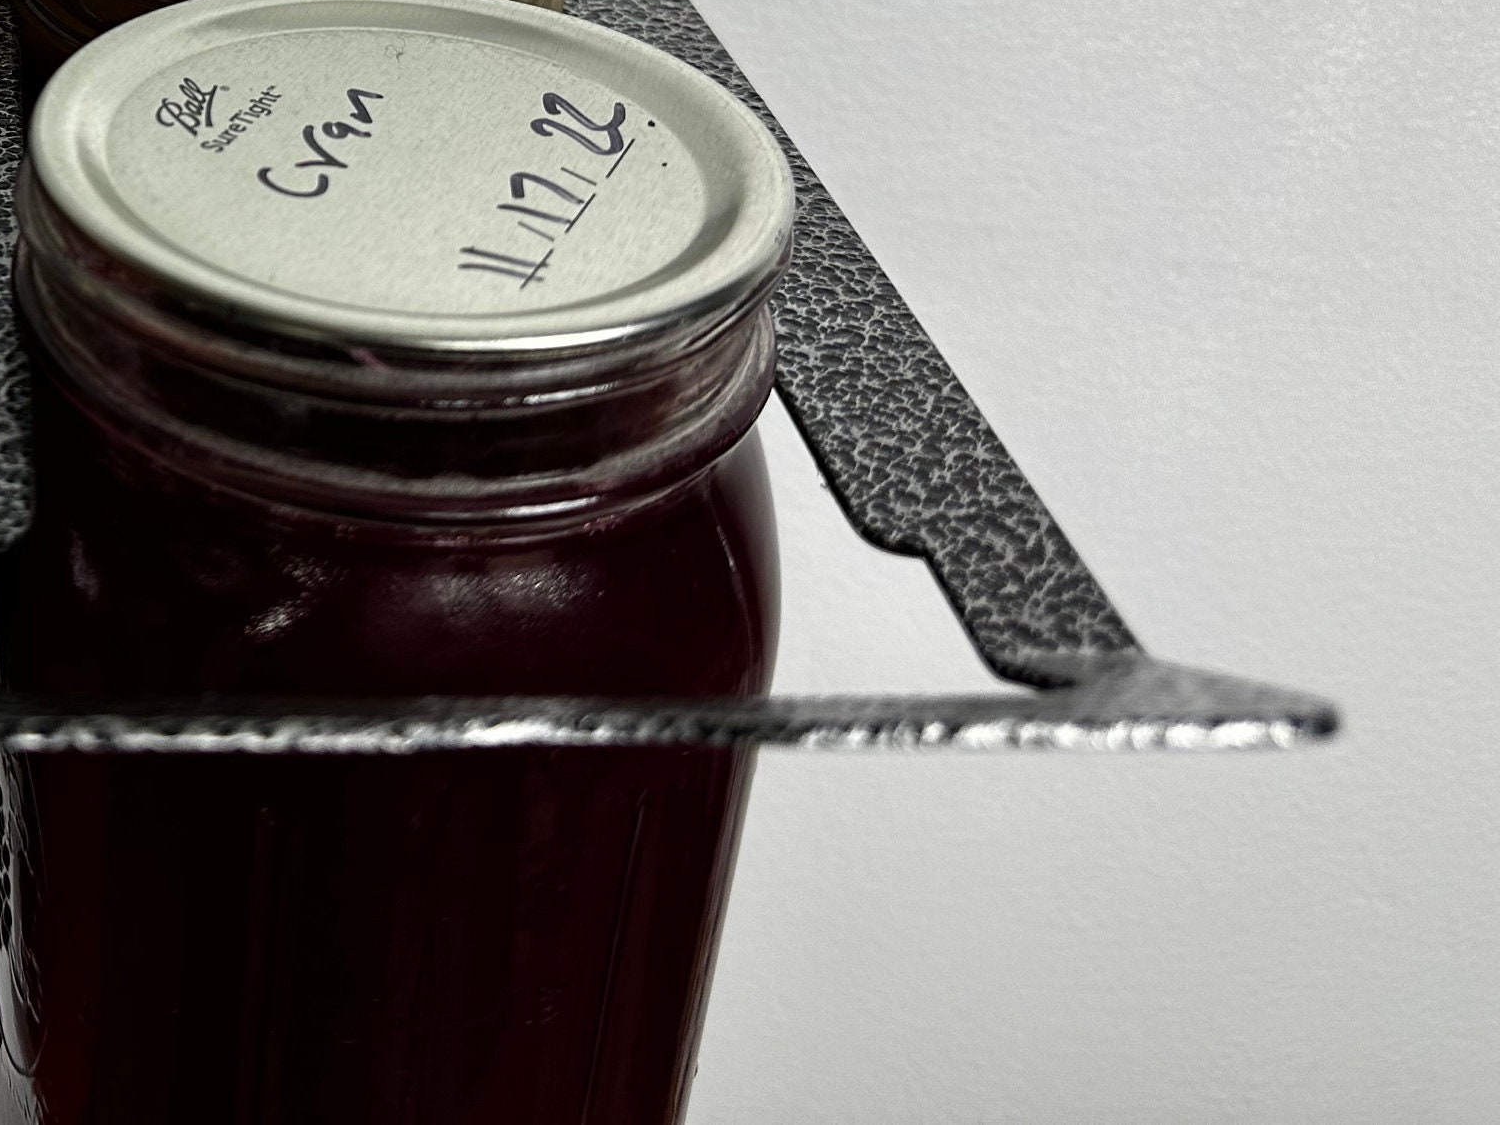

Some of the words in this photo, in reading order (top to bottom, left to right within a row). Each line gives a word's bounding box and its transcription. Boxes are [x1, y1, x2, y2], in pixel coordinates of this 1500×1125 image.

[155, 77, 218, 137] Ball
[200, 84, 283, 154] SureTight
[256, 88, 384, 198] Cran
